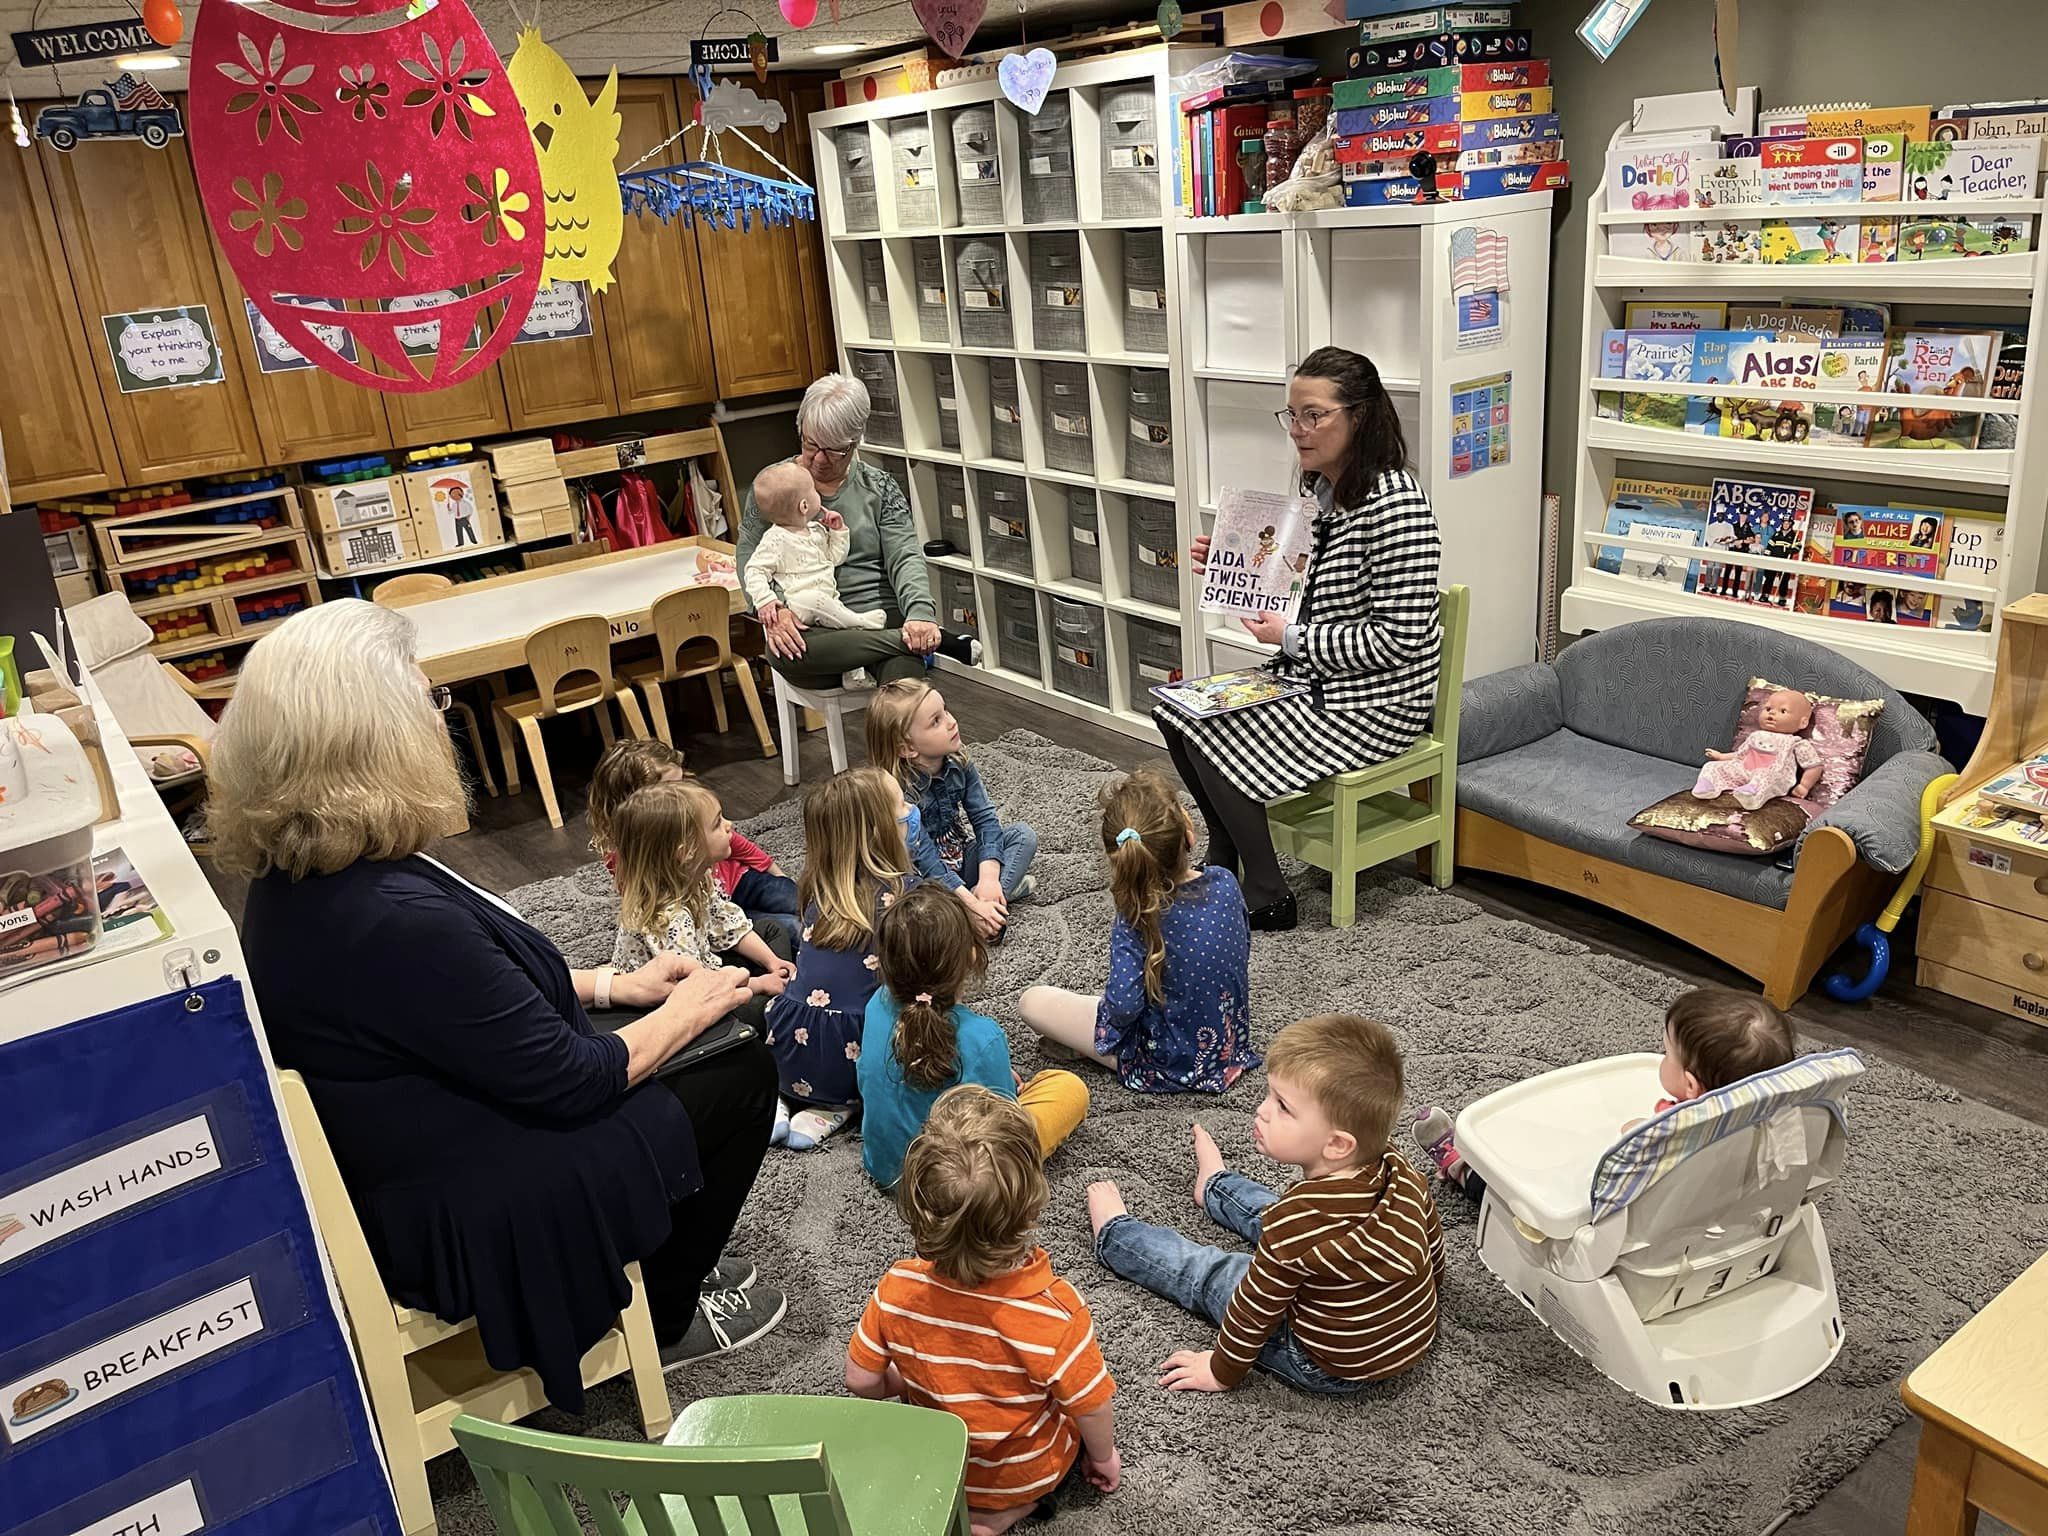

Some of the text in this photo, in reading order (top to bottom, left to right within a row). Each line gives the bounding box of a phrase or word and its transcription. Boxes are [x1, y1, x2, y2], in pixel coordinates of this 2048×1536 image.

[1474, 12, 1490, 24] ABC
[1394, 21, 1410, 31] ABC
[32, 25, 152, 59] WELCOME
[1492, 69, 1515, 82] Blokus
[1376, 80, 1407, 95] Blokus
[1495, 94, 1517, 109] Blokus
[1378, 108, 1409, 122] Blokus
[1493, 124, 1520, 140] Blokus
[1973, 120, 2011, 138] John,
[1372, 135, 1405, 151] Blokus
[1868, 145, 1888, 155] -op
[1833, 146, 1847, 157] -ill
[1633, 154, 1661, 169] What
[1970, 155, 2013, 174] Dear
[1621, 164, 1674, 188] Darla
[1782, 168, 1839, 182] Jumping Jill
[1872, 167, 1891, 177] the
[1507, 173, 1532, 187] Blokus
[1768, 179, 1854, 191] Went Down the Hill
[1959, 172, 2027, 195] Teacher,
[1391, 183, 1419, 197] Blokus
[1719, 188, 1763, 205] Babies
[413, 298, 439, 308] What
[557, 299, 574, 308] way
[536, 313, 547, 321] do
[549, 309, 574, 319] that?
[403, 326, 430, 335] think
[1742, 315, 1754, 331] A
[1758, 313, 1787, 332] Dog
[1790, 315, 1833, 339] Needs
[141, 328, 182, 340] Explain
[127, 340, 203, 358] your thinking
[1636, 344, 1679, 360] Prairie
[1703, 341, 1727, 353] Flap
[1699, 354, 1725, 366] Your
[1854, 355, 1878, 365] Earth
[1912, 344, 1954, 366] Red
[150, 358, 166, 367] to
[1915, 364, 1947, 382] Hen
[1760, 377, 1787, 388] ABC
[1713, 483, 1763, 507] ABC
[1767, 492, 1808, 510] JOBS
[1641, 527, 1666, 538] BUNNY
[1666, 531, 1681, 540] FUN
[1867, 523, 1909, 537] ALIKE
[1210, 549, 1245, 569] ADA
[1843, 548, 1931, 569] DIFFERENT
[1946, 547, 1998, 575] Jump
[1204, 586, 1290, 612] SCIENTIST
[30, 1141, 211, 1227] WASH HANDS
[83, 1300, 252, 1391] BREAKFAST
